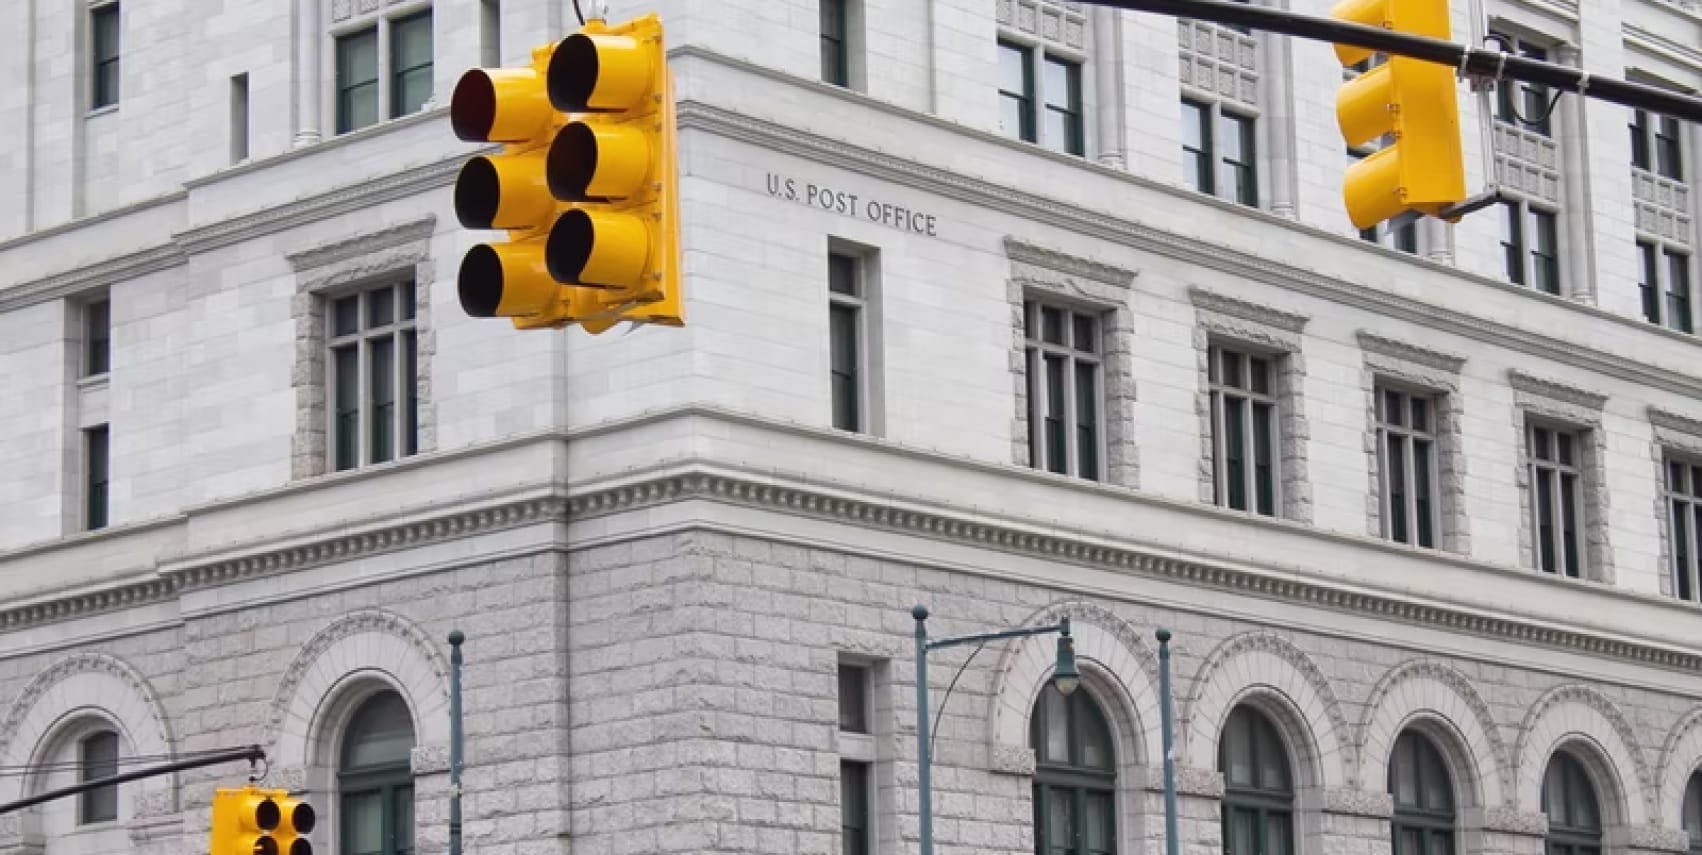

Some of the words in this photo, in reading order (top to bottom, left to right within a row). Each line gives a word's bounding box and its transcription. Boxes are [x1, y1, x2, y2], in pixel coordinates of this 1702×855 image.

[767, 172, 800, 200] U.S.
[807, 184, 858, 216] POST
[867, 200, 937, 236] OFFICE
